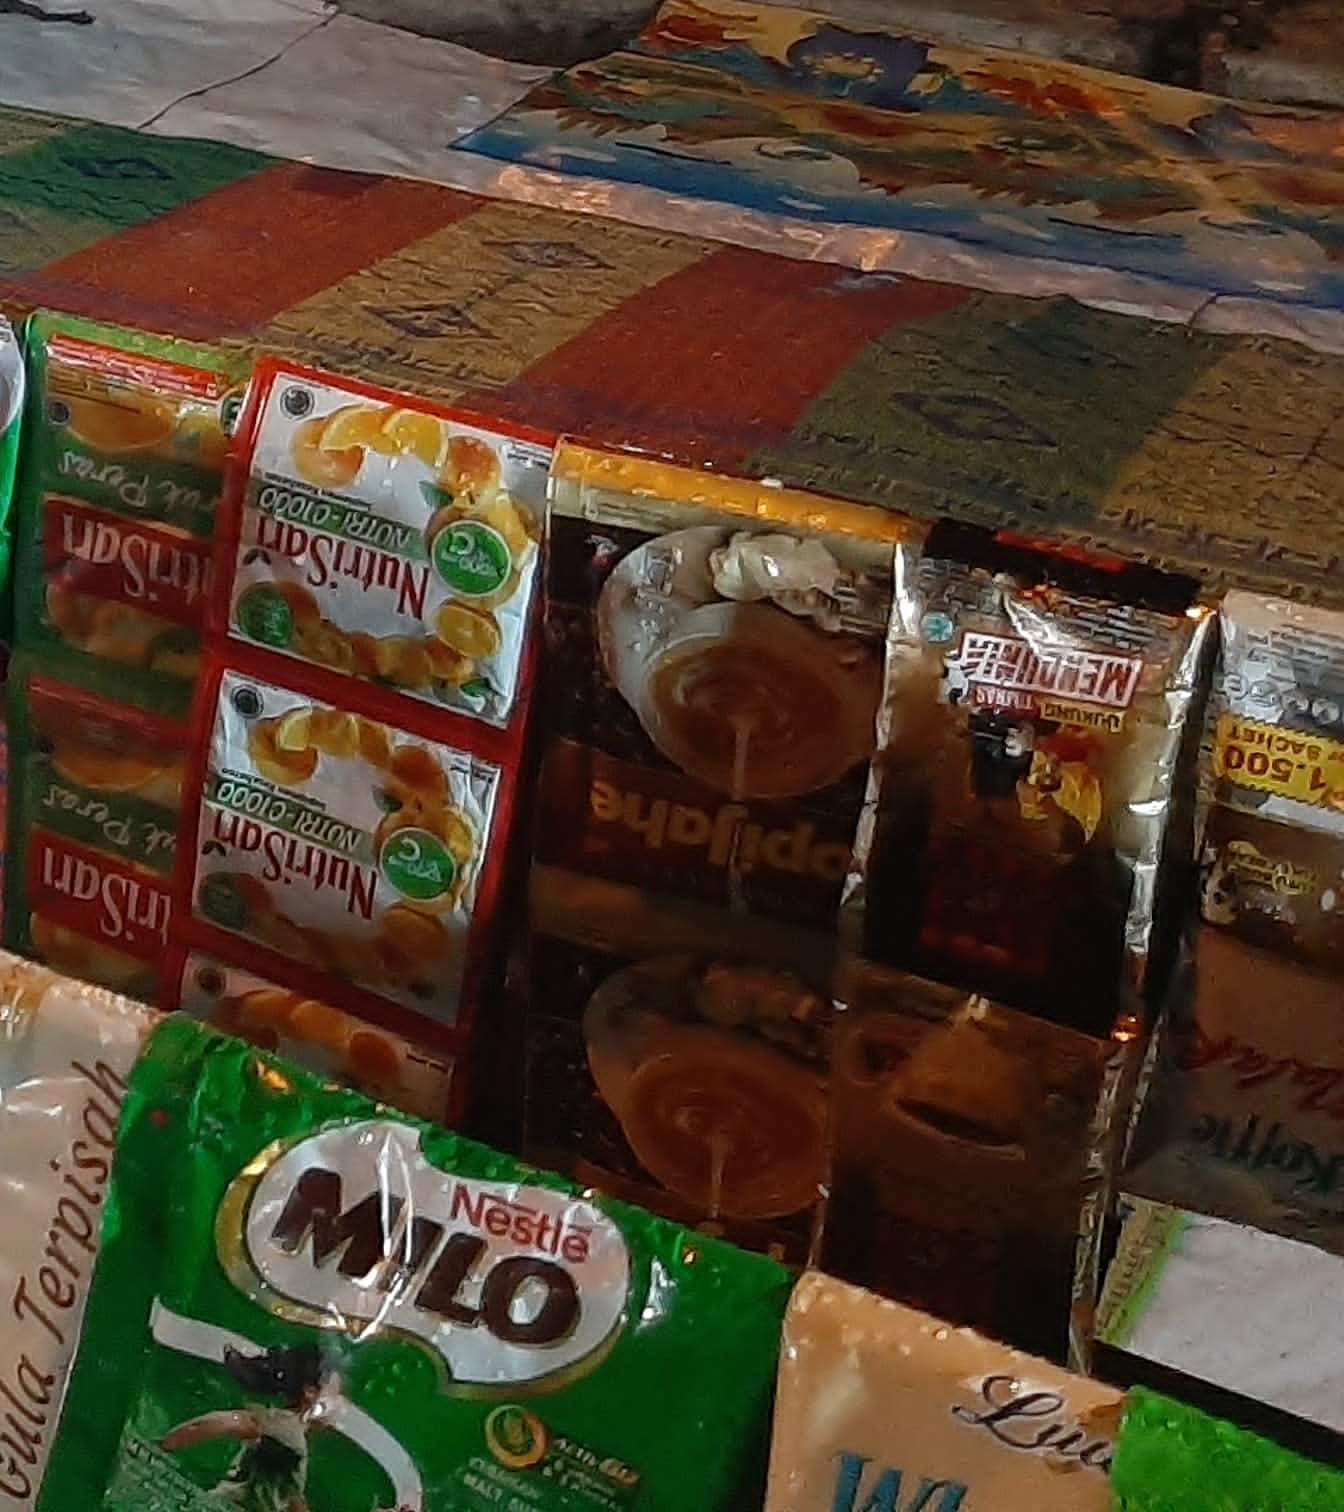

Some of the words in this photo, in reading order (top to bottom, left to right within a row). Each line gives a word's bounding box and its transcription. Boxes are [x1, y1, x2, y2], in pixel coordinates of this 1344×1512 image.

[257, 515, 430, 621] NutriSari
[1223, 744, 1328, 791] 1.500
[213, 806, 379, 921] NutriSari
[11, 1058, 129, 1346] Terpisah
[270, 1166, 585, 1347] MILO
